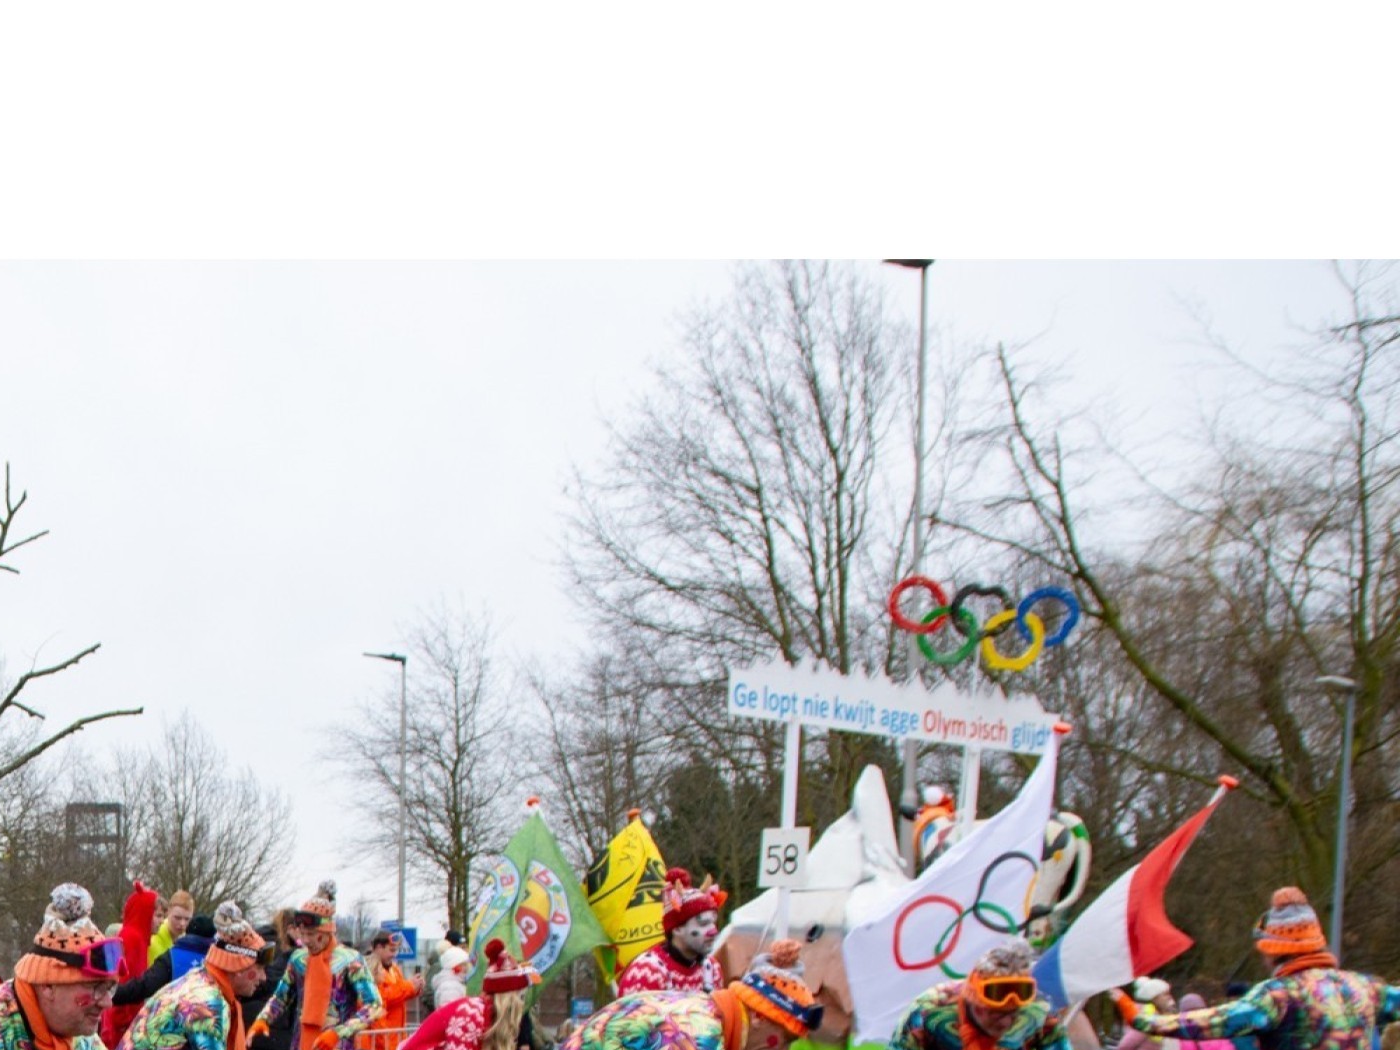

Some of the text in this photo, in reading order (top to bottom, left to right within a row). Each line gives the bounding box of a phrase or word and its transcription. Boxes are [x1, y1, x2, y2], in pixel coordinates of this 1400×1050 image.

[734, 682, 758, 708] Ge
[764, 685, 798, 717] lopt
[803, 693, 829, 718] nie
[834, 695, 876, 729] kwijt
[880, 708, 919, 734] agge
[1012, 721, 1051, 750] glijd
[766, 843, 799, 875] 58
